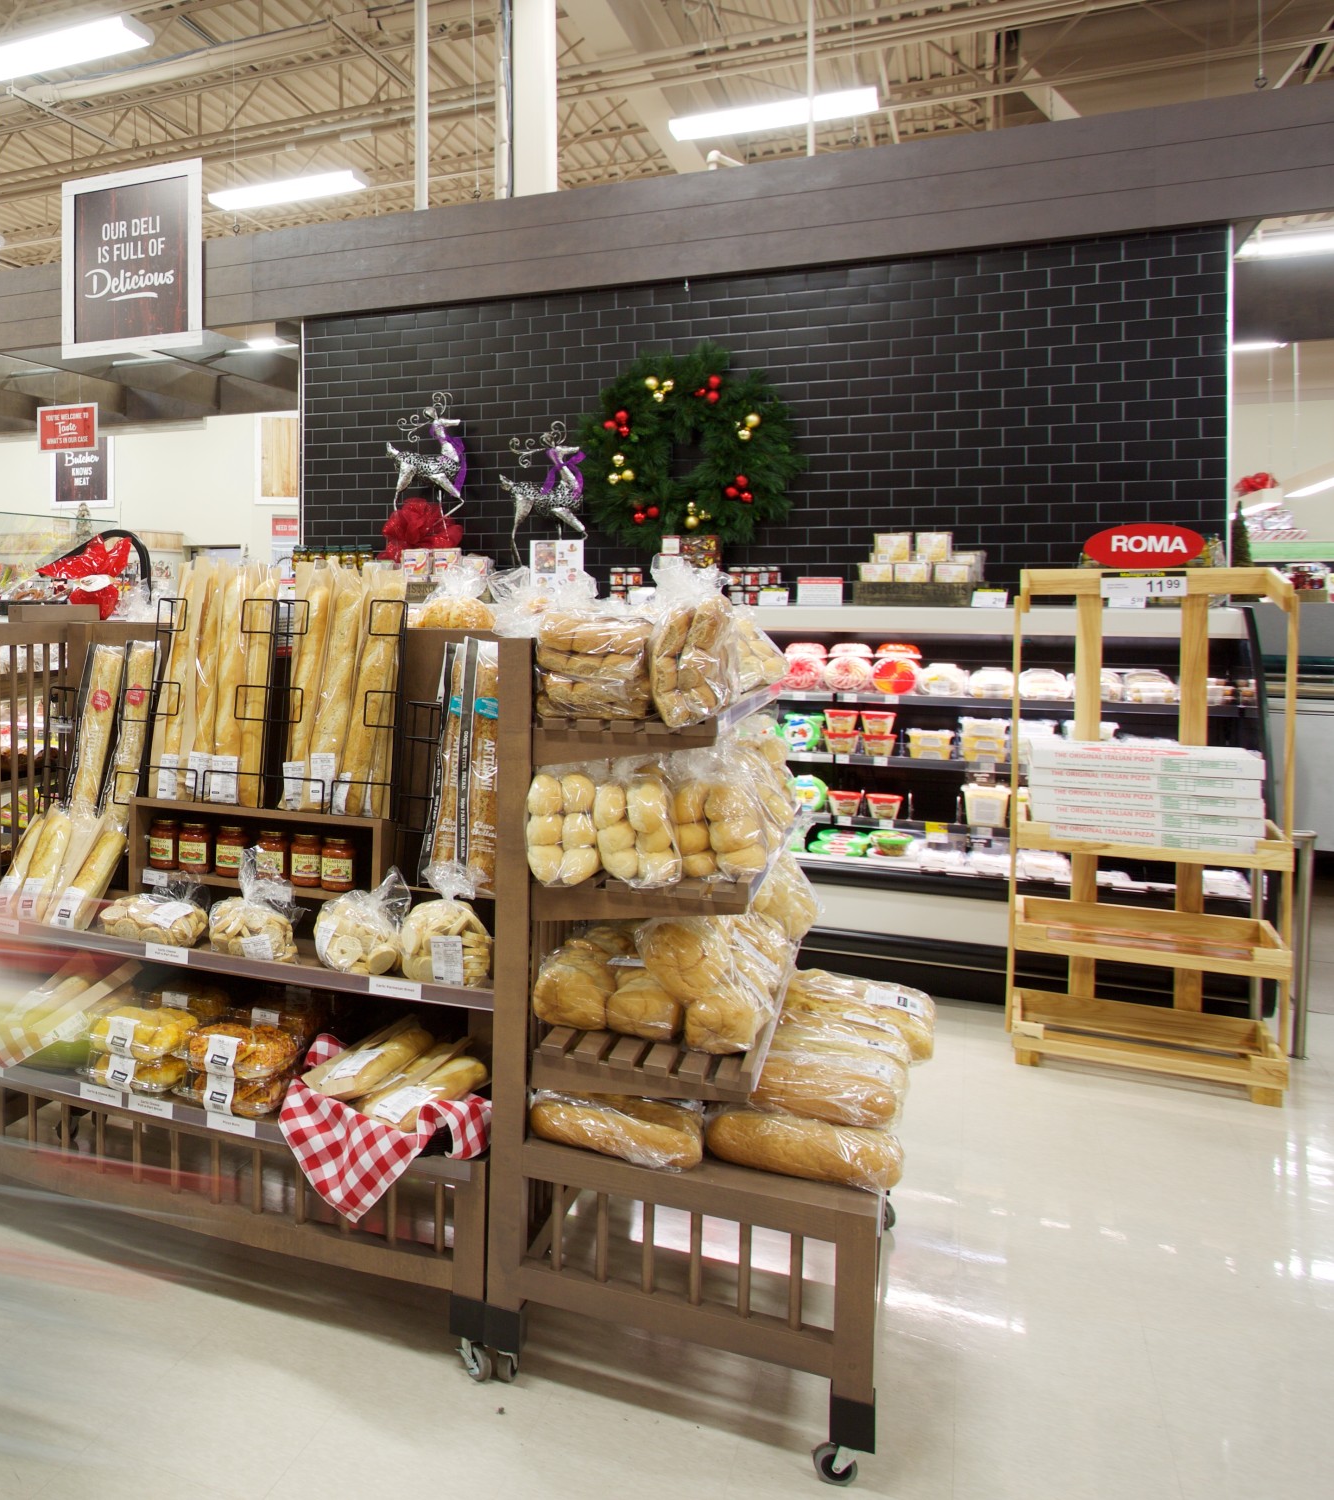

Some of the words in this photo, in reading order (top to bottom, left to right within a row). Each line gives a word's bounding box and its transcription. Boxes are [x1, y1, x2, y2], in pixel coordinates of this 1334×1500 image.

[102, 221, 127, 241] OUR
[131, 215, 160, 236] DELI
[97, 246, 110, 264] IS
[113, 240, 145, 262] FULL
[148, 237, 166, 257] OF
[84, 268, 175, 299] Delicious
[61, 412, 82, 420] WELCOME
[83, 411, 89, 419] TO
[54, 421, 77, 434] Taste
[47, 437, 62, 445] WHAT'S
[68, 436, 77, 444] OUR
[78, 435, 88, 443] CASE
[64, 451, 100, 466] Butcher
[71, 467, 93, 476] KNOWS
[74, 477, 90, 486] MEAT
[1110, 535, 1187, 553] ROMA
[1069, 752, 1102, 760] ORIGINAL
[1068, 789, 1101, 797] ORIGINAL
[1104, 791, 1131, 799] ITALIAN
[1070, 807, 1103, 815] ORIGINAL
[1106, 809, 1133, 817] ITALIAN
[473, 820, 495, 830] Ciao
[1069, 825, 1103, 833] ORIGINAL
[1105, 828, 1132, 836] ITALIAN
